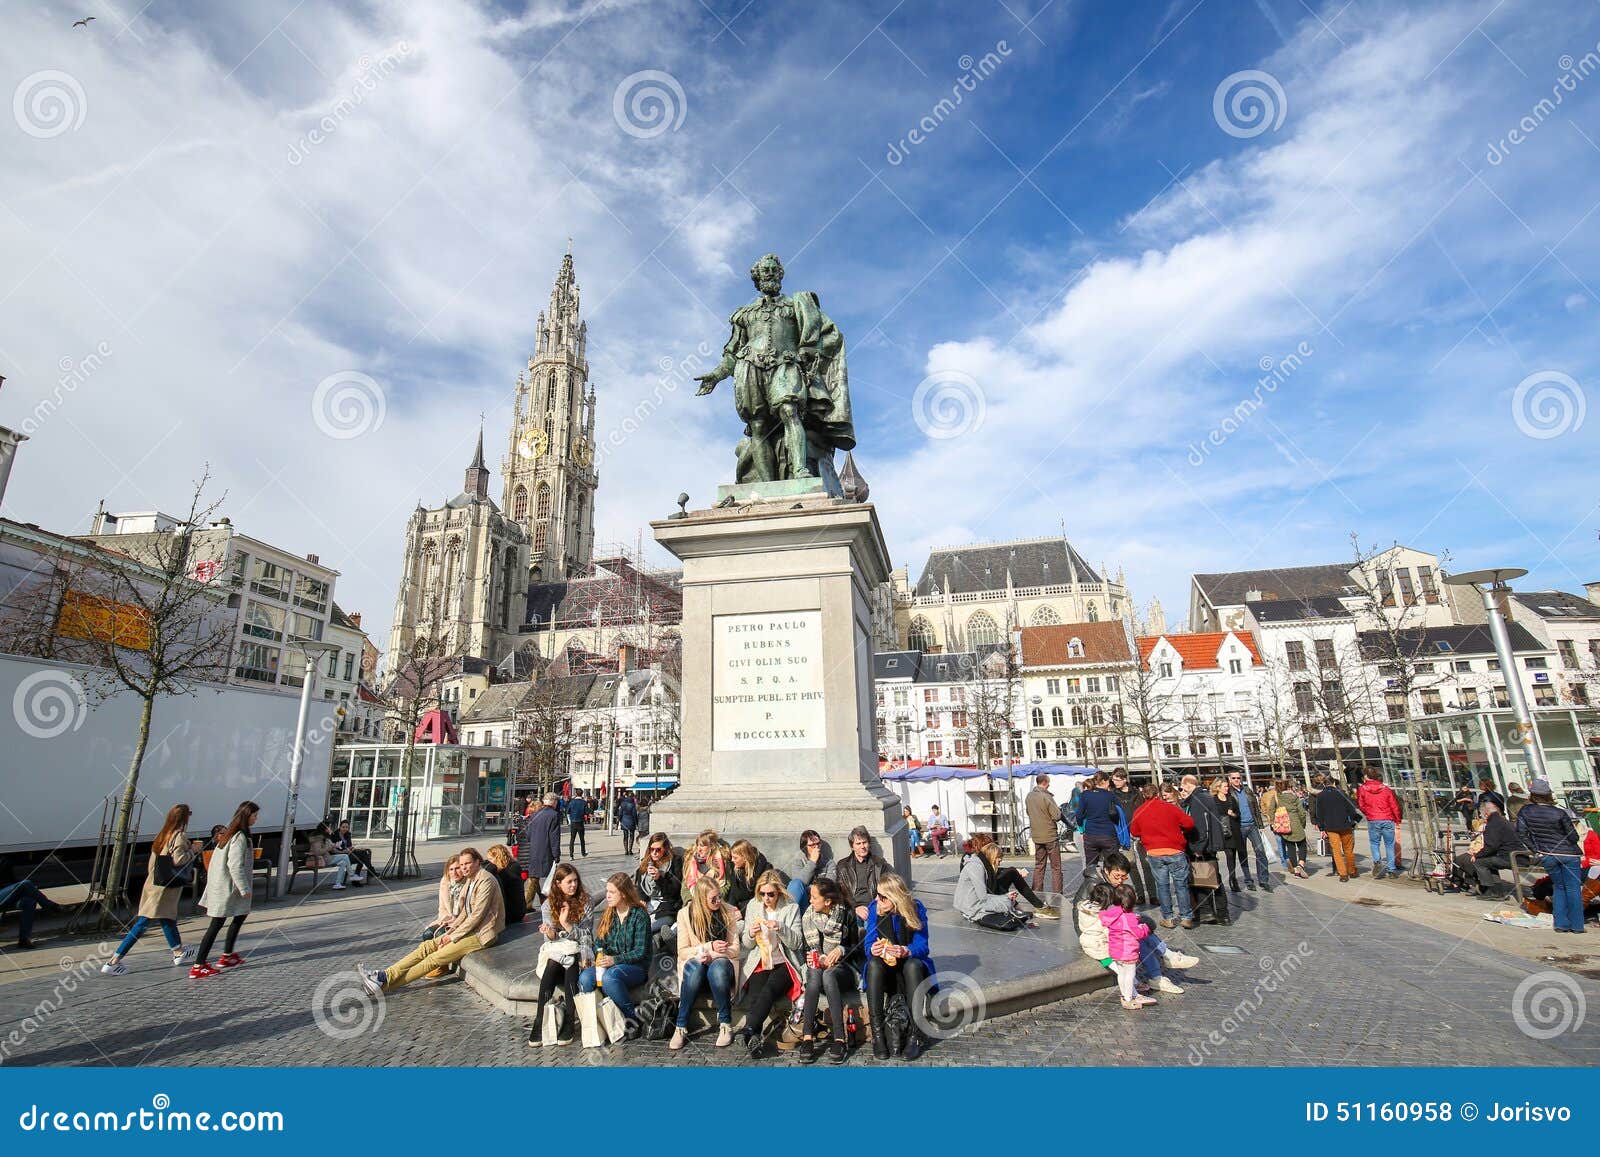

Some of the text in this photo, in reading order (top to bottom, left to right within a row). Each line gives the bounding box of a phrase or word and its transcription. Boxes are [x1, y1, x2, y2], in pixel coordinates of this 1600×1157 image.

[728, 621, 806, 632] PETRO PAULO
[744, 639, 791, 649] RUBENS
[756, 658, 782, 666] OLIM
[787, 656, 808, 664] SUO
[786, 693, 798, 701] ET
[734, 729, 806, 740] MDCCCXXXX
